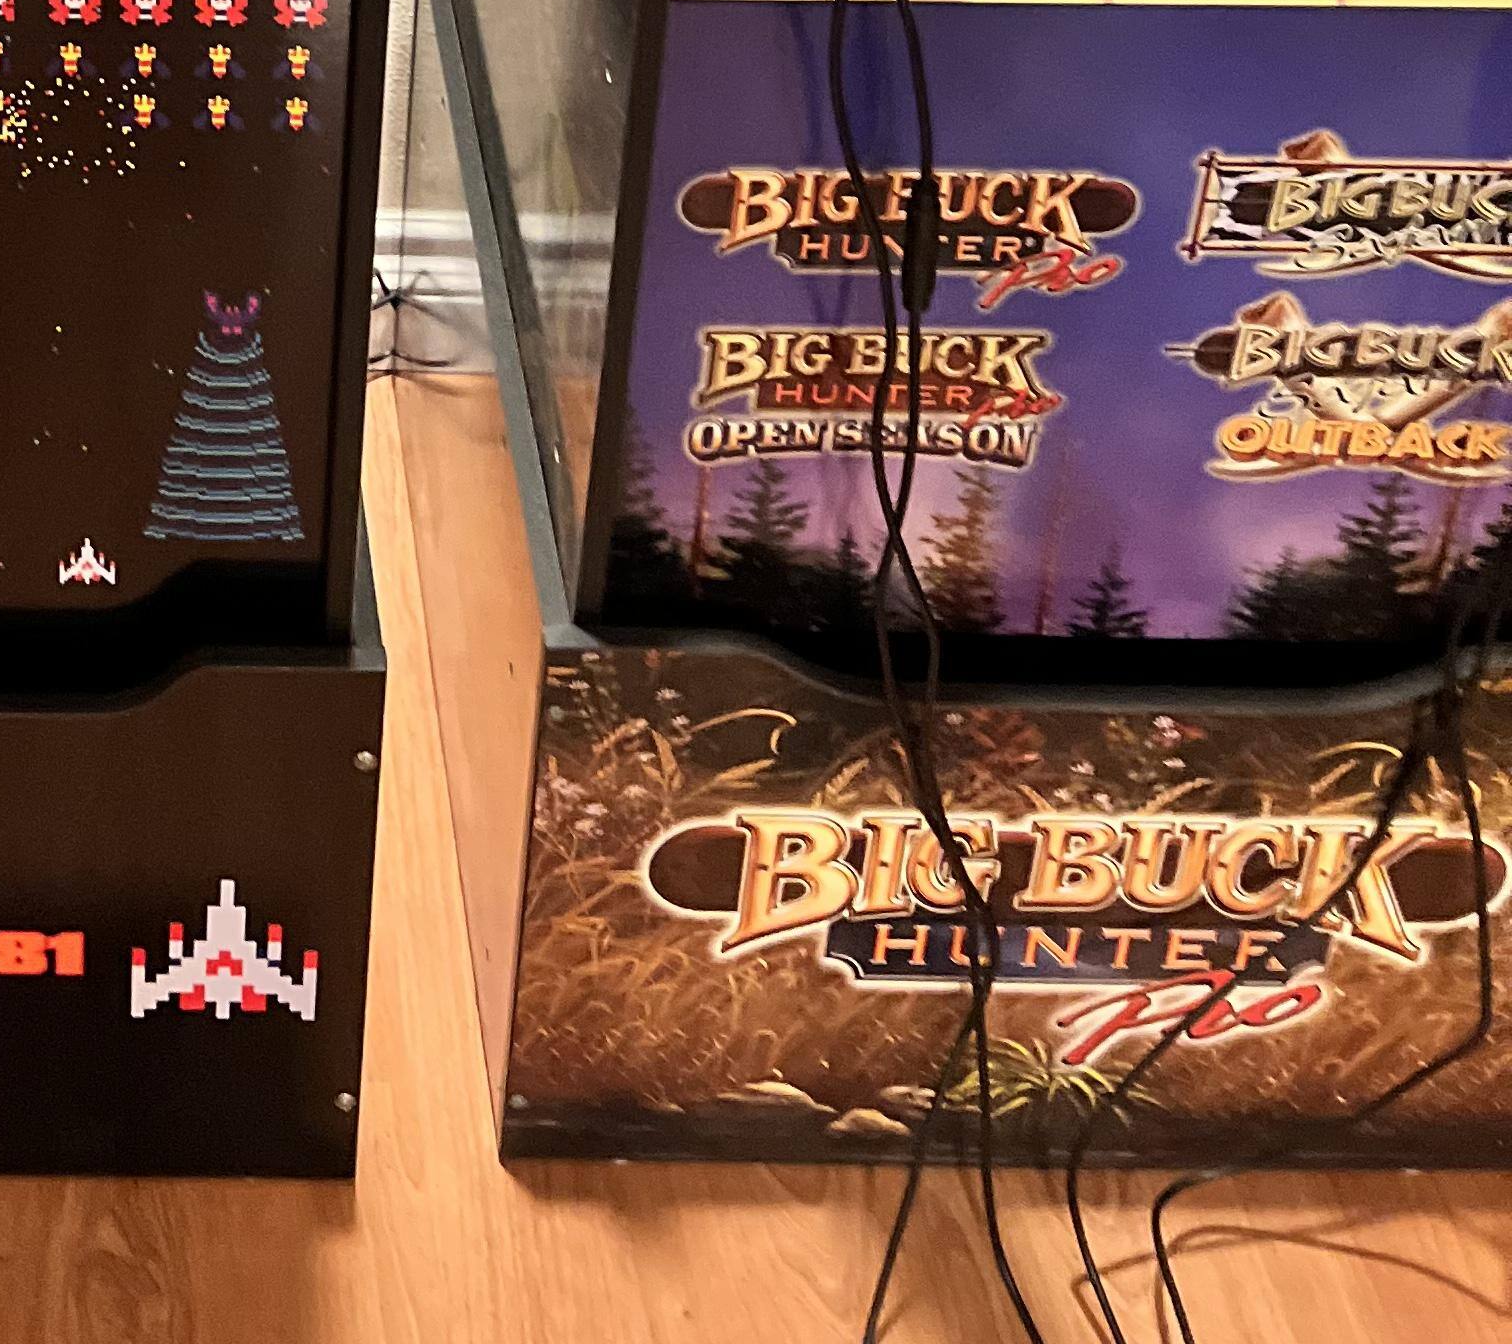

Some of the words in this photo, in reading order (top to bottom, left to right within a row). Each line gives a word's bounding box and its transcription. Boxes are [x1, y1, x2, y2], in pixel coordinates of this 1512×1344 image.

[720, 169, 859, 251] BIG
[1269, 176, 1382, 232] BIG
[699, 333, 832, 402] BIG
[845, 335, 1041, 401] BUCK
[1230, 323, 1350, 380] BIG
[776, 384, 974, 406] HUNTER
[689, 418, 822, 455] OPEN
[1221, 416, 1510, 461] OUTBACK
[722, 814, 1002, 954] BIG
[1014, 817, 1437, 963] BUCK
[1057, 969, 1322, 1066] Pro
